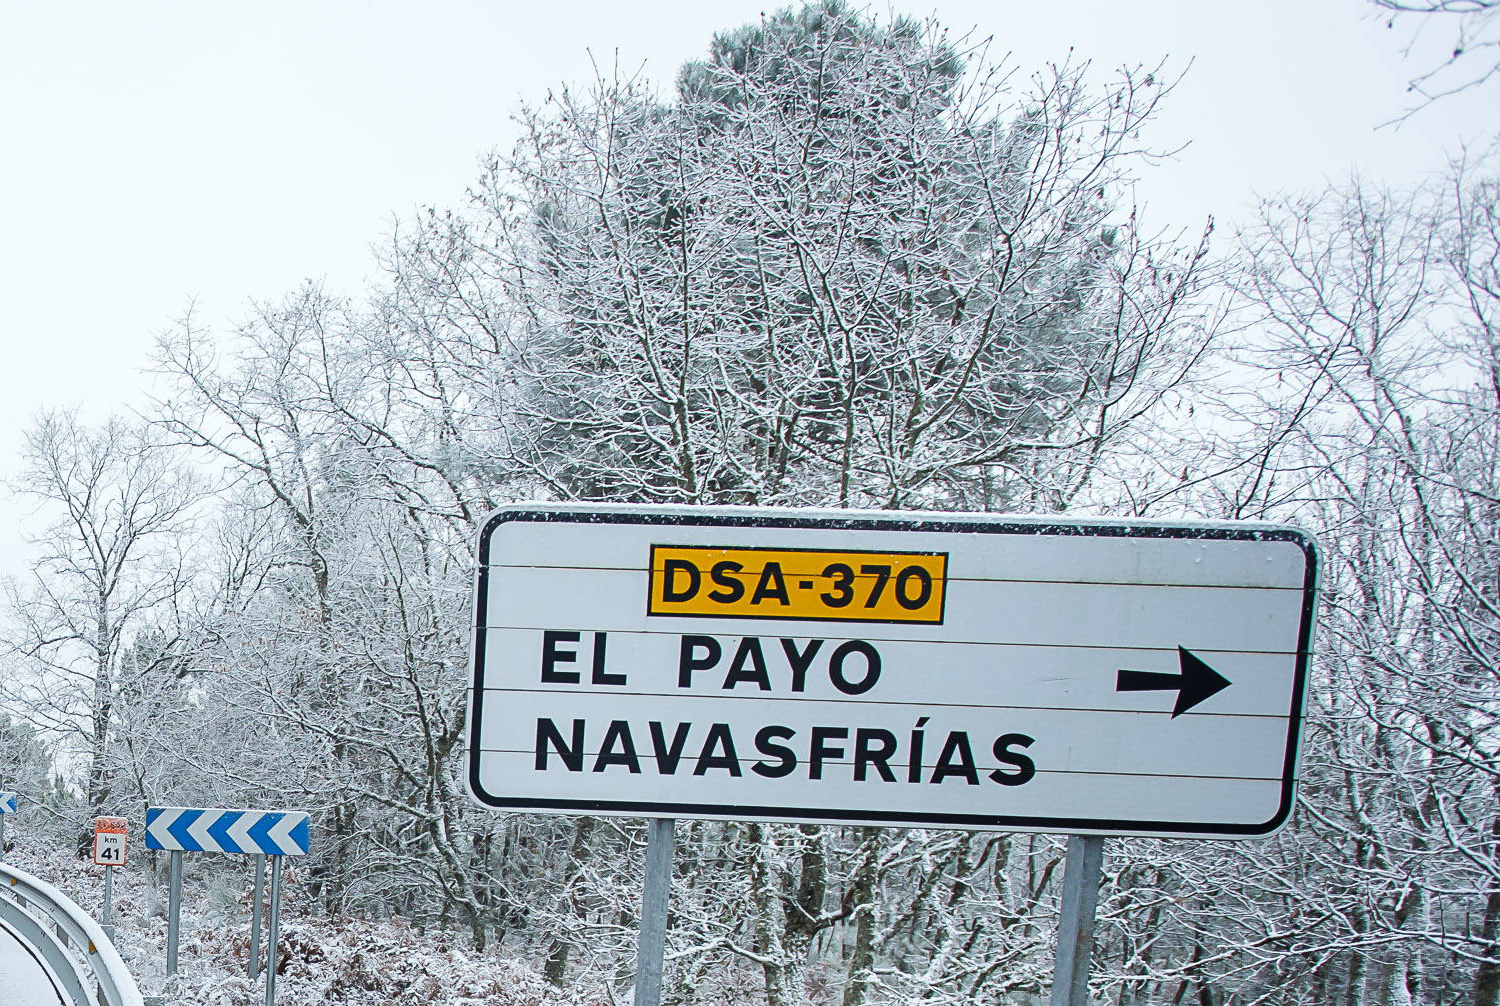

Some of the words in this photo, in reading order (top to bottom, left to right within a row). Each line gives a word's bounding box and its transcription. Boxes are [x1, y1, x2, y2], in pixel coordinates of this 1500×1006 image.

[661, 558, 933, 612] DSA-370
[541, 630, 627, 686] EL
[678, 634, 882, 696] PAYO
[535, 717, 1037, 787] NAVASFRÍAS
[101, 847, 120, 861] 41
[104, 836, 118, 844] km
